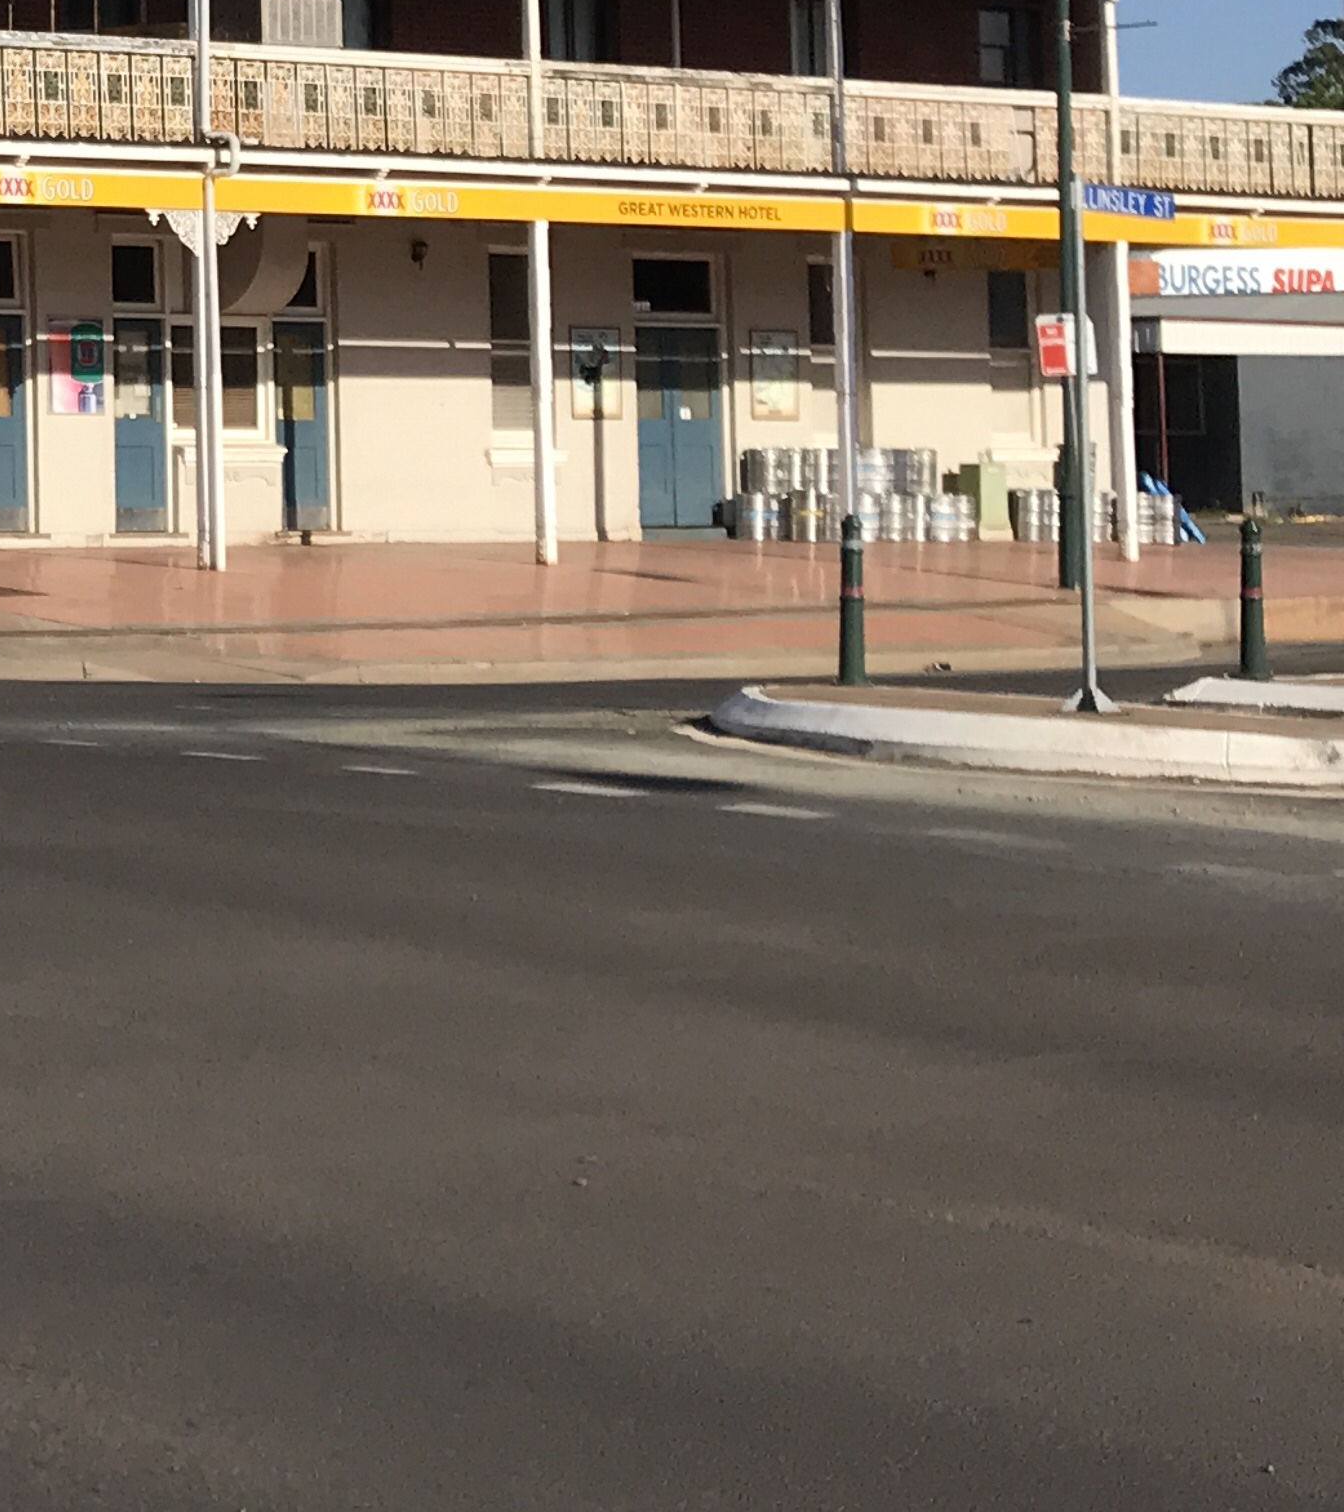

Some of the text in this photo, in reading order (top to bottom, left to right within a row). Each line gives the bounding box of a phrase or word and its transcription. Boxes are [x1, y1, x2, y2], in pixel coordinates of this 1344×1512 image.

[41, 175, 95, 201] GOLD
[368, 189, 460, 214] XXXX GOLD
[618, 201, 782, 221] GREAT WESTERN HOTEL
[1153, 193, 1171, 219] ST
[1158, 264, 1336, 295] BURGESS SUPA
